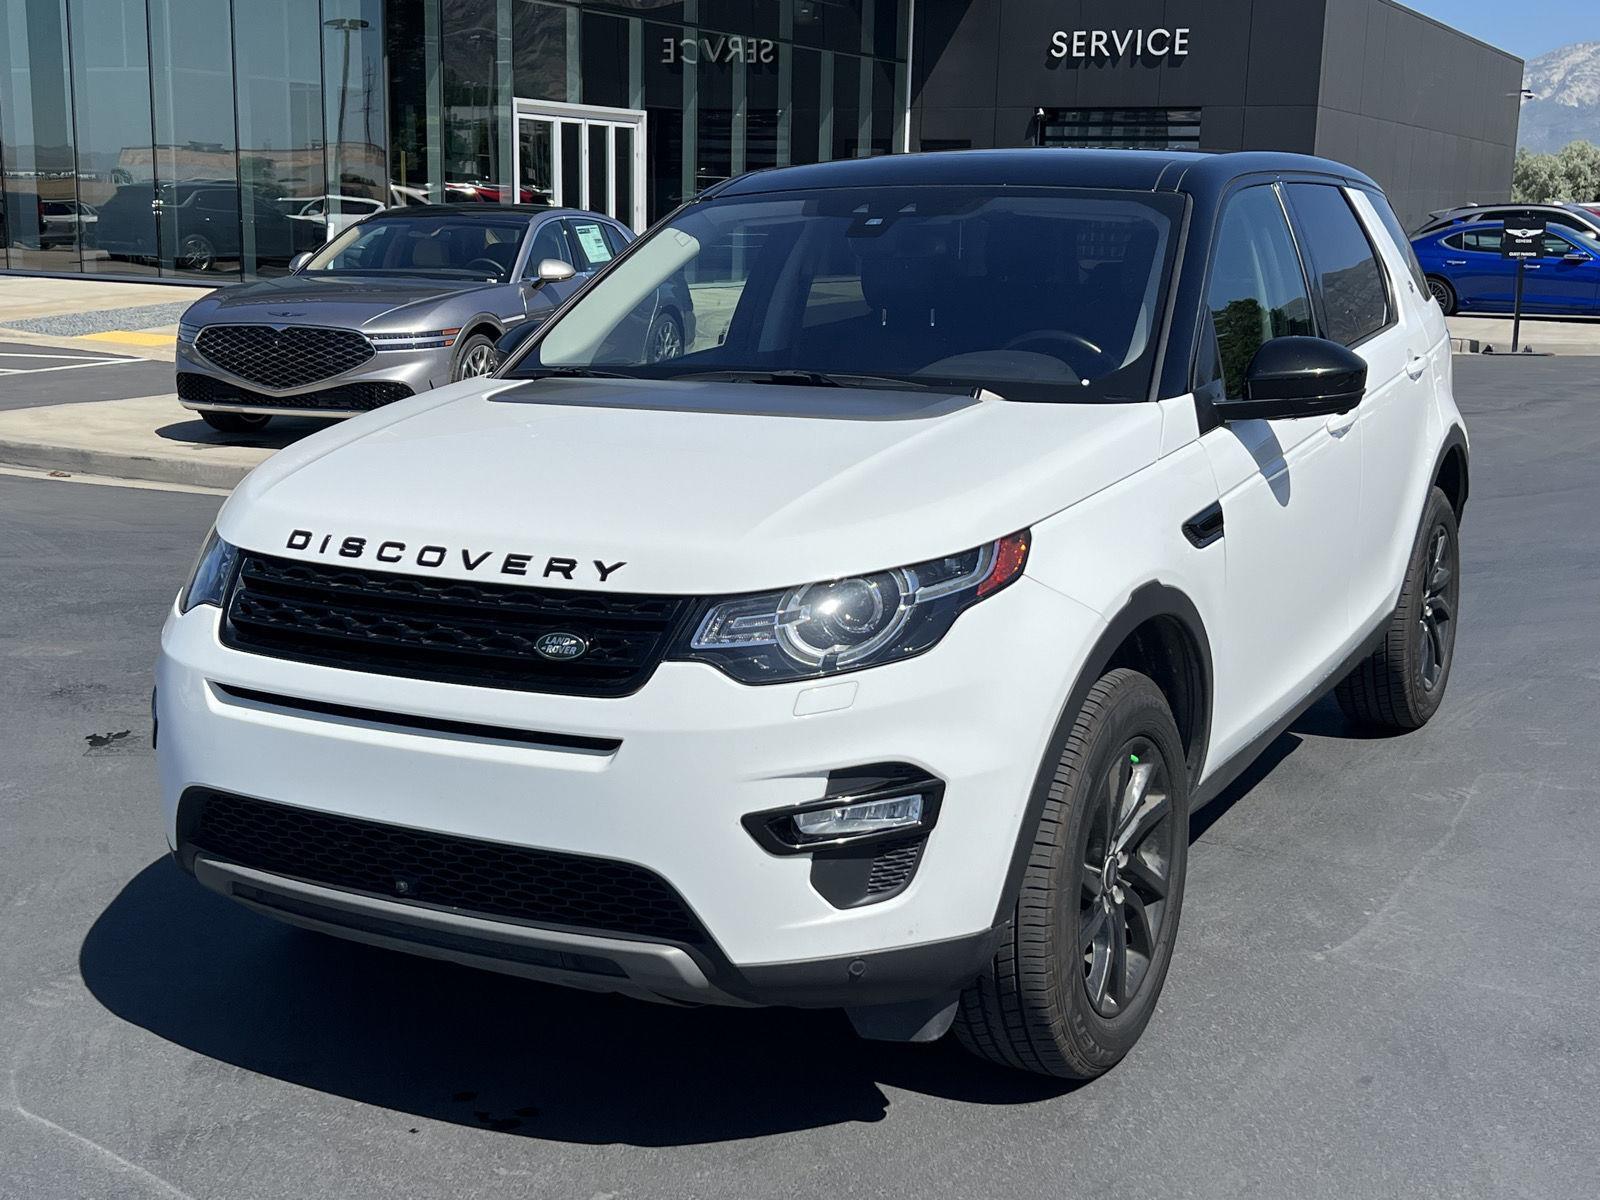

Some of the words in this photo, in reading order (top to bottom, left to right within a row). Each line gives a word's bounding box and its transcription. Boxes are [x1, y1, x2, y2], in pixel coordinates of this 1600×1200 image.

[1050, 28, 1190, 58] SERVICE
[286, 529, 627, 582] DISCOVERY
[545, 636, 571, 646] LAND
[545, 645, 577, 655] ROVER
